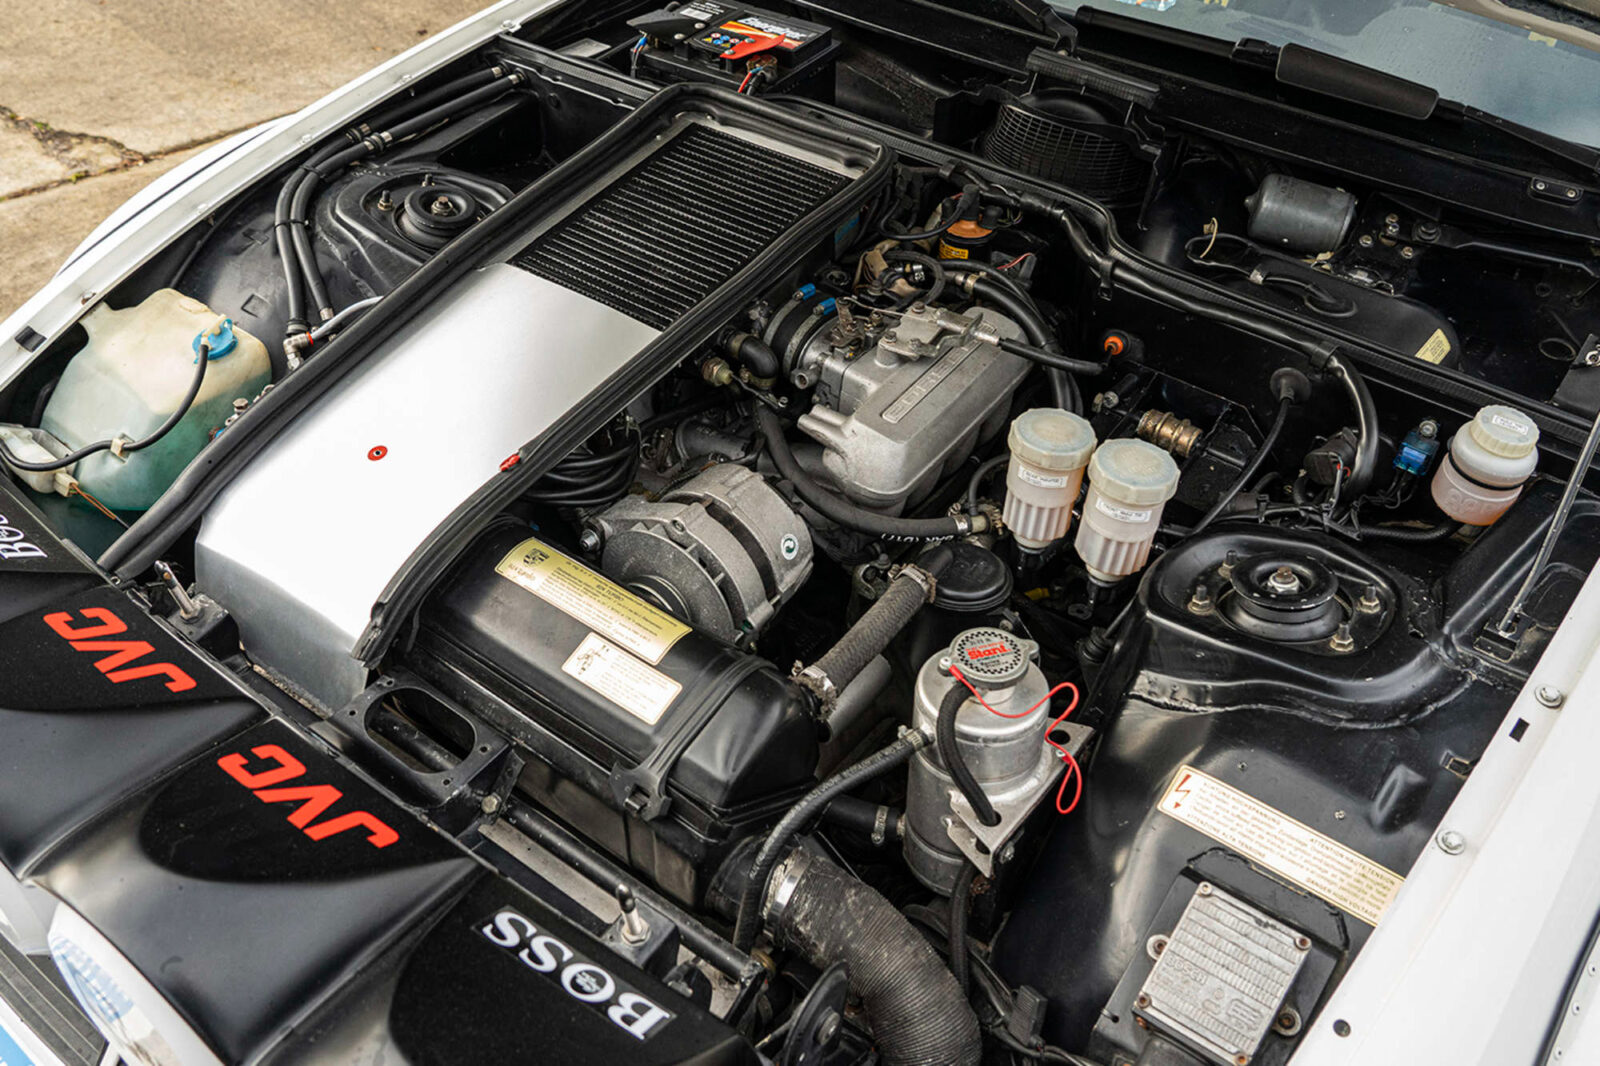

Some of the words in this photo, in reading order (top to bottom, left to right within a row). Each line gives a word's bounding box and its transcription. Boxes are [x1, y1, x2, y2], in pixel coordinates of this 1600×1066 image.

[0, 513, 48, 559] BO
[43, 607, 197, 693] JVC
[968, 644, 1008, 660] Stant
[217, 744, 400, 849] JVC
[482, 911, 670, 1041] BOSS
[1165, 956, 1208, 986] BOSCH
